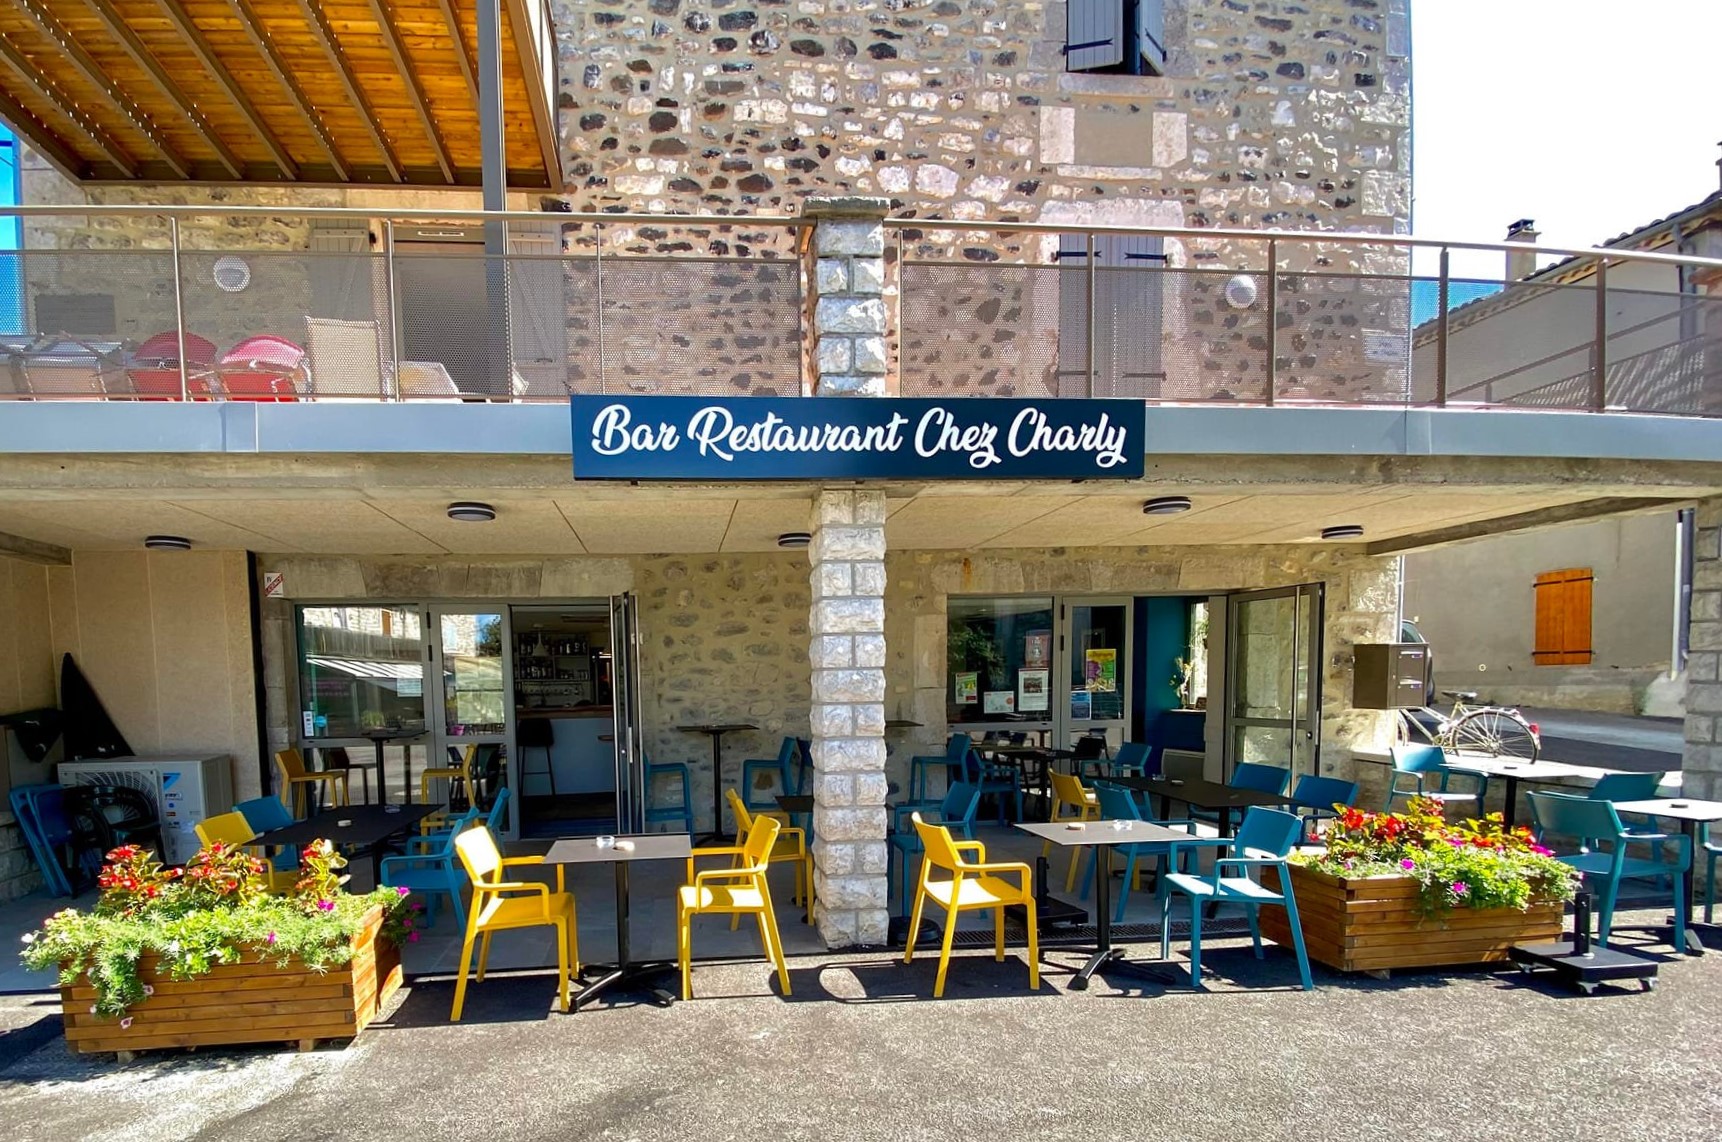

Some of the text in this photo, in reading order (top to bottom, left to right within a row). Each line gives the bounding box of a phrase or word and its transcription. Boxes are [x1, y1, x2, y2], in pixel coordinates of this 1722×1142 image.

[591, 403, 1128, 469] Bar Restaurant Chez Charly
